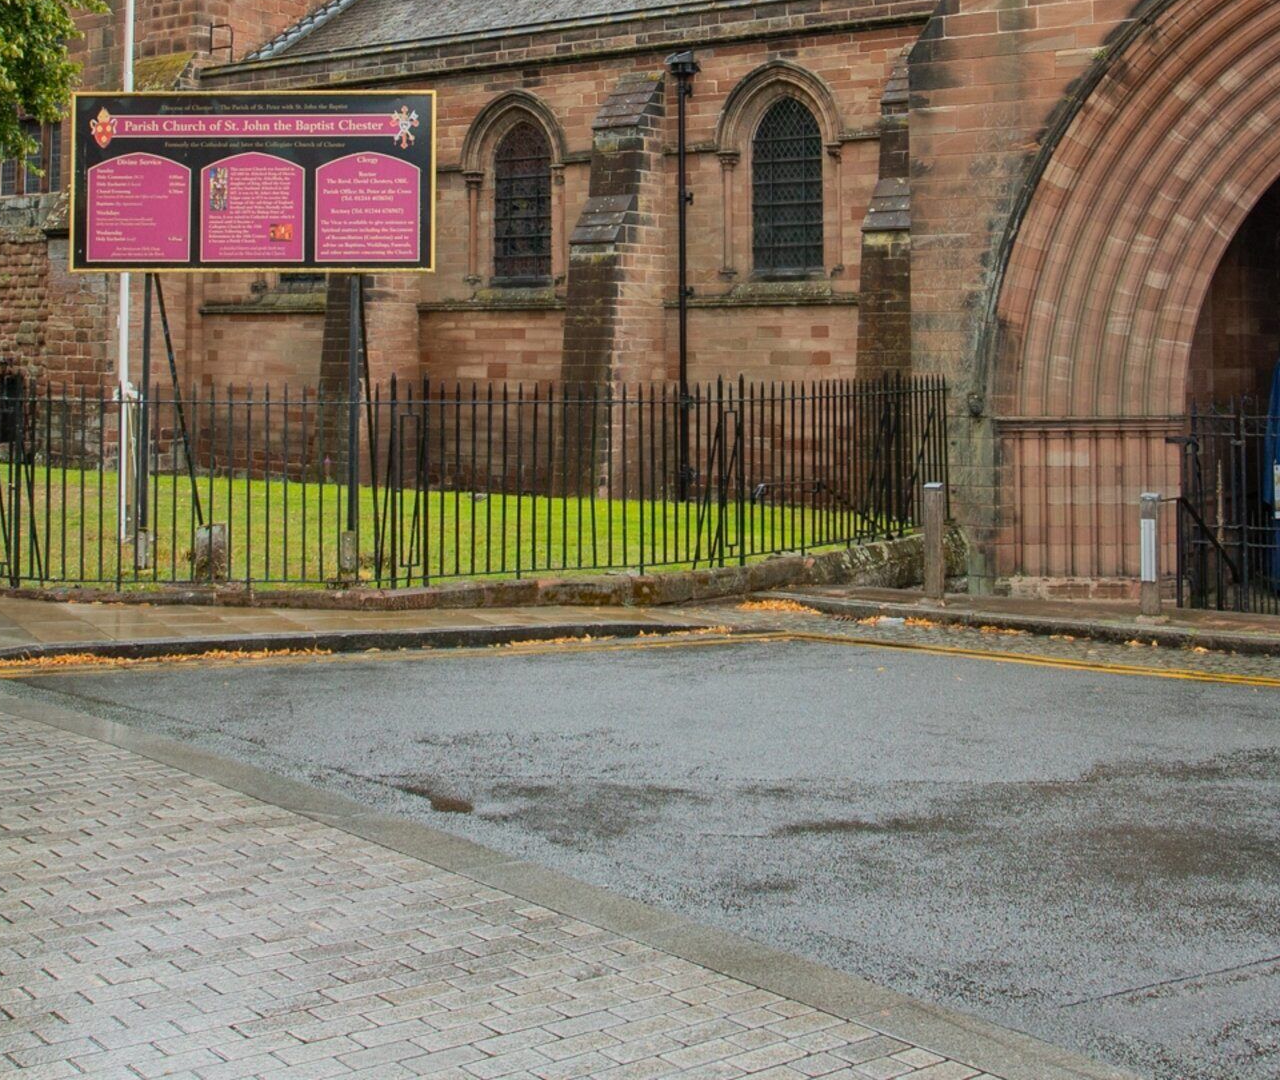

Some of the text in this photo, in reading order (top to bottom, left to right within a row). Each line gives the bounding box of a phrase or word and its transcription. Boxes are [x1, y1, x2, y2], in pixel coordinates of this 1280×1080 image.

[125, 119, 383, 133] Parish Church of St. John the Baptist Chester
[357, 156, 378, 164] Clergy
